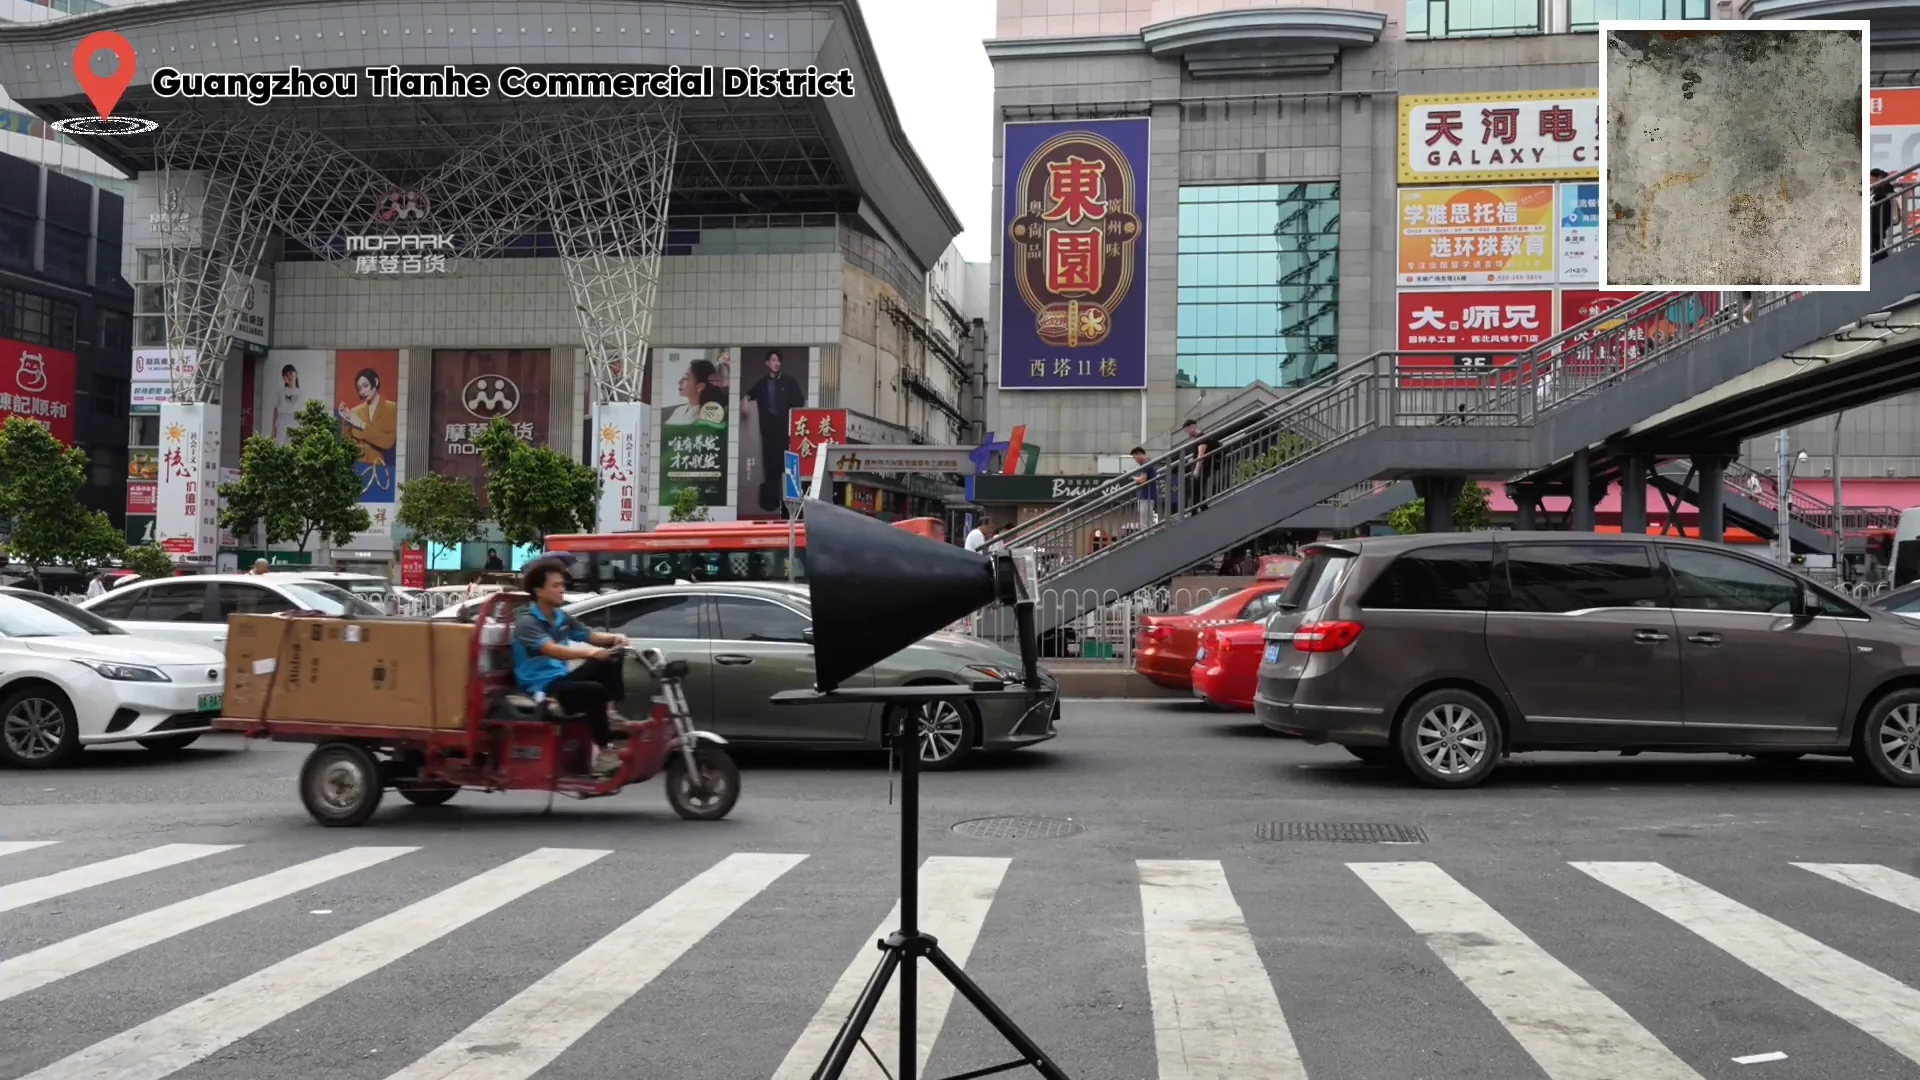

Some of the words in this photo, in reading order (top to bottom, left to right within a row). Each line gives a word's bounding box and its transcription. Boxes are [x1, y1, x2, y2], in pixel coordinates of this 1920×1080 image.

[1425, 105, 1600, 146] 天河电
[1427, 147, 1545, 166] GALAXY
[1403, 202, 1518, 225] 学雅思托福
[346, 235, 455, 250] MOPARK
[1430, 235, 1545, 258] 选环球教育
[355, 254, 446, 274] 摩登百货
[1029, 357, 1118, 378] 西塔11楼
[444, 422, 534, 443] 摩登货
